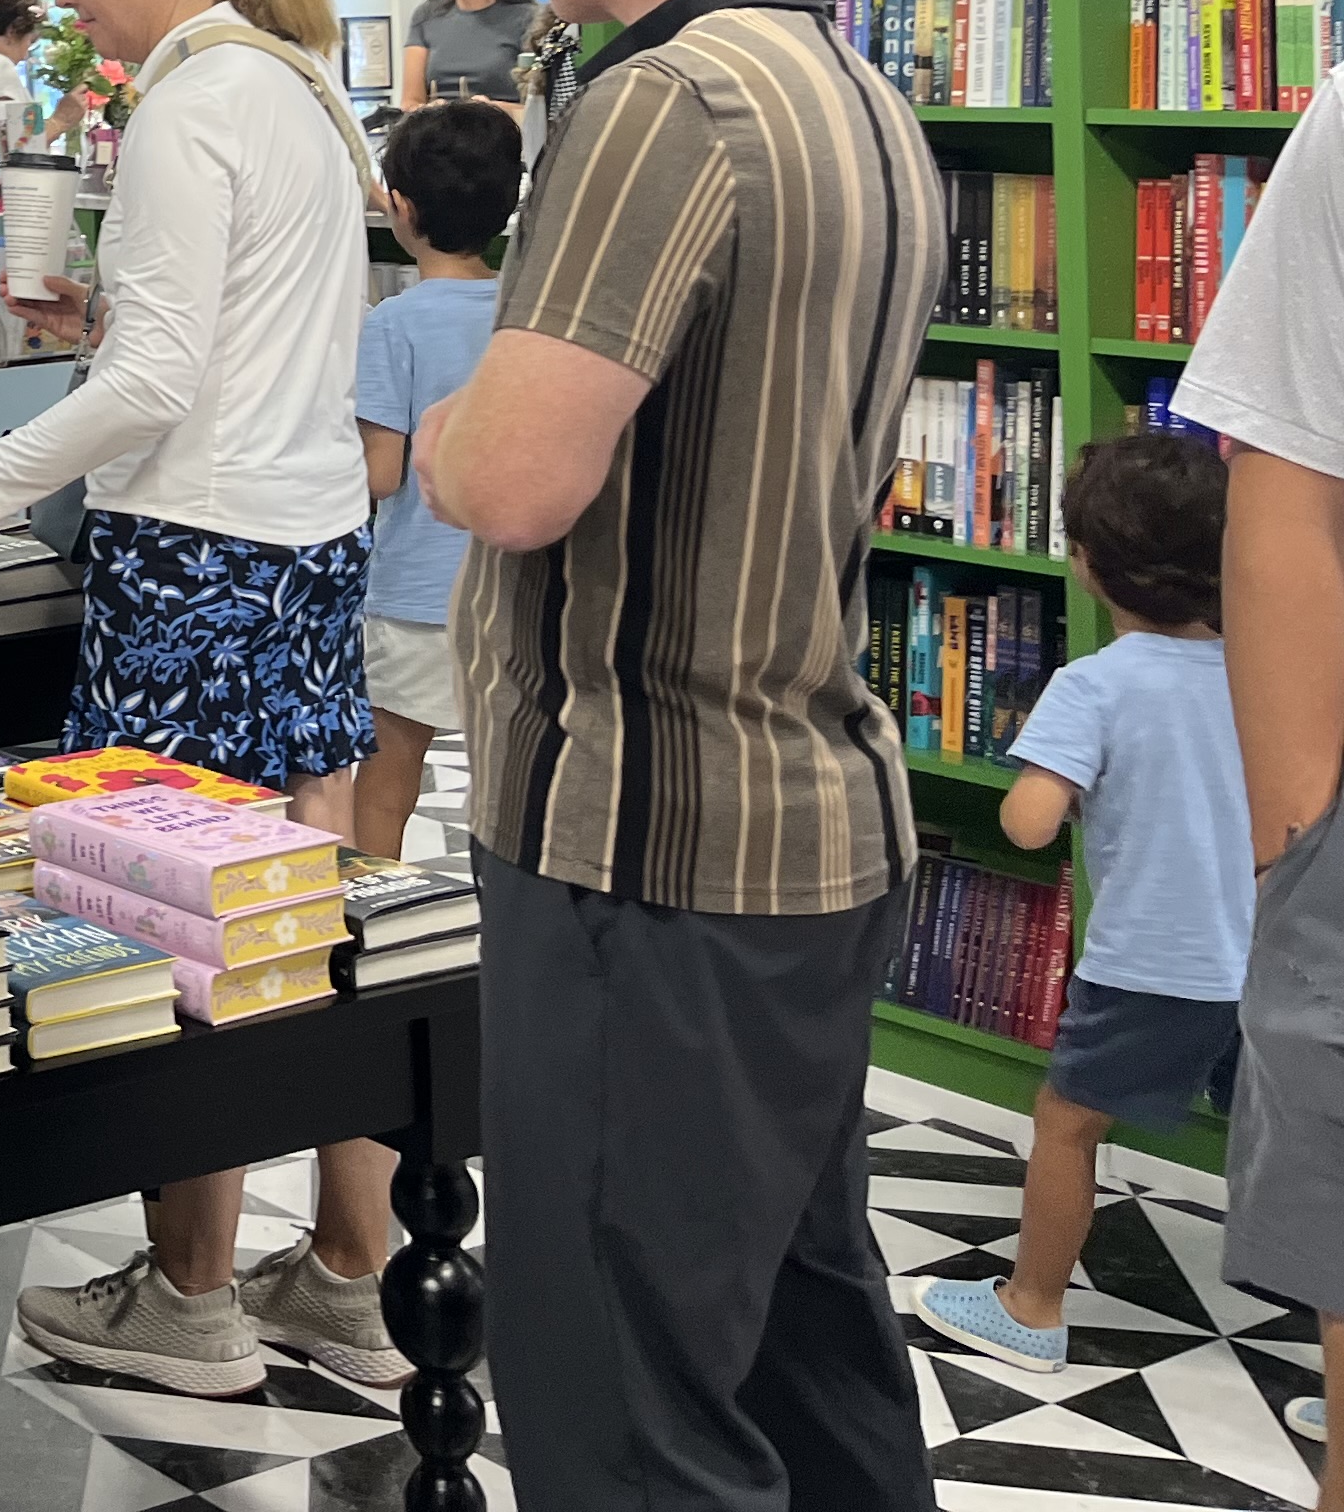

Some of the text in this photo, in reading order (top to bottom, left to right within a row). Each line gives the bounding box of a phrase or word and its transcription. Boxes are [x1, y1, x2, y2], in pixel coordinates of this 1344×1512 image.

[1203, 24, 1211, 49] KEVIN
[1195, 228, 1209, 274] AUTHOR
[960, 264, 970, 296] ROAD
[978, 264, 988, 297] ROAD
[1032, 397, 1041, 428] WOULD
[934, 465, 943, 503] ALASKA
[90, 795, 169, 813] THINGS
[134, 803, 169, 816] WE
[143, 810, 193, 826] LEFT
[152, 813, 232, 834] BEHIND
[12, 941, 142, 978] MY FRIENDS
